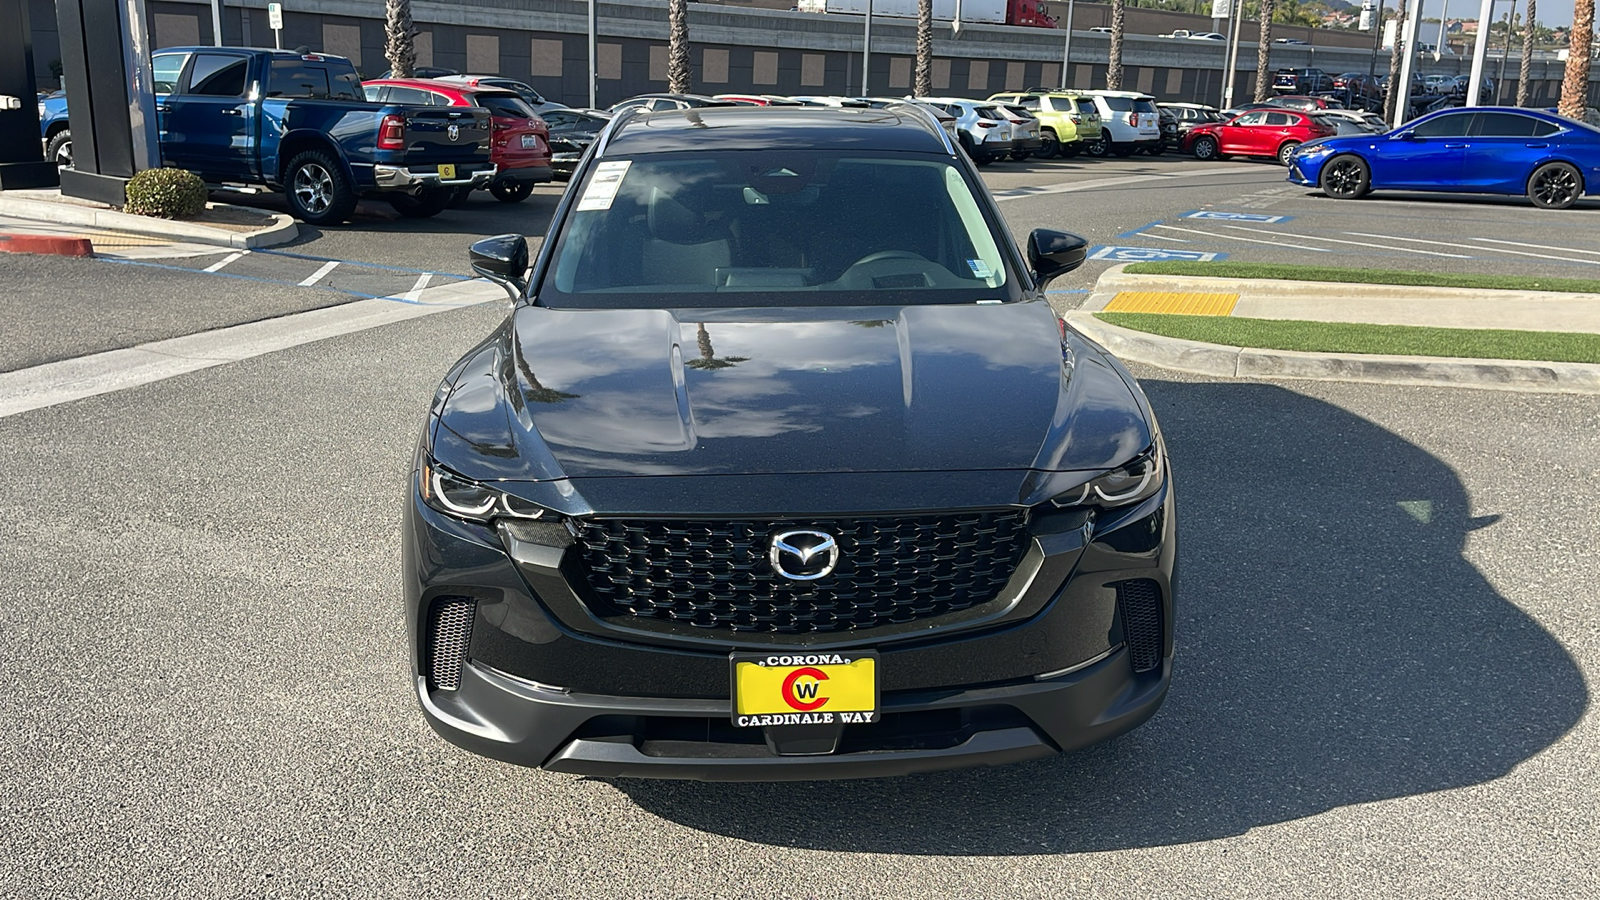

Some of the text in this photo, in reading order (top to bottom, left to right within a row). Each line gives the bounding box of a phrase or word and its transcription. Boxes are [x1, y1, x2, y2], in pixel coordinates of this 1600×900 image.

[766, 654, 844, 666] CORONA
[738, 711, 874, 727] CARDINALE WAY
